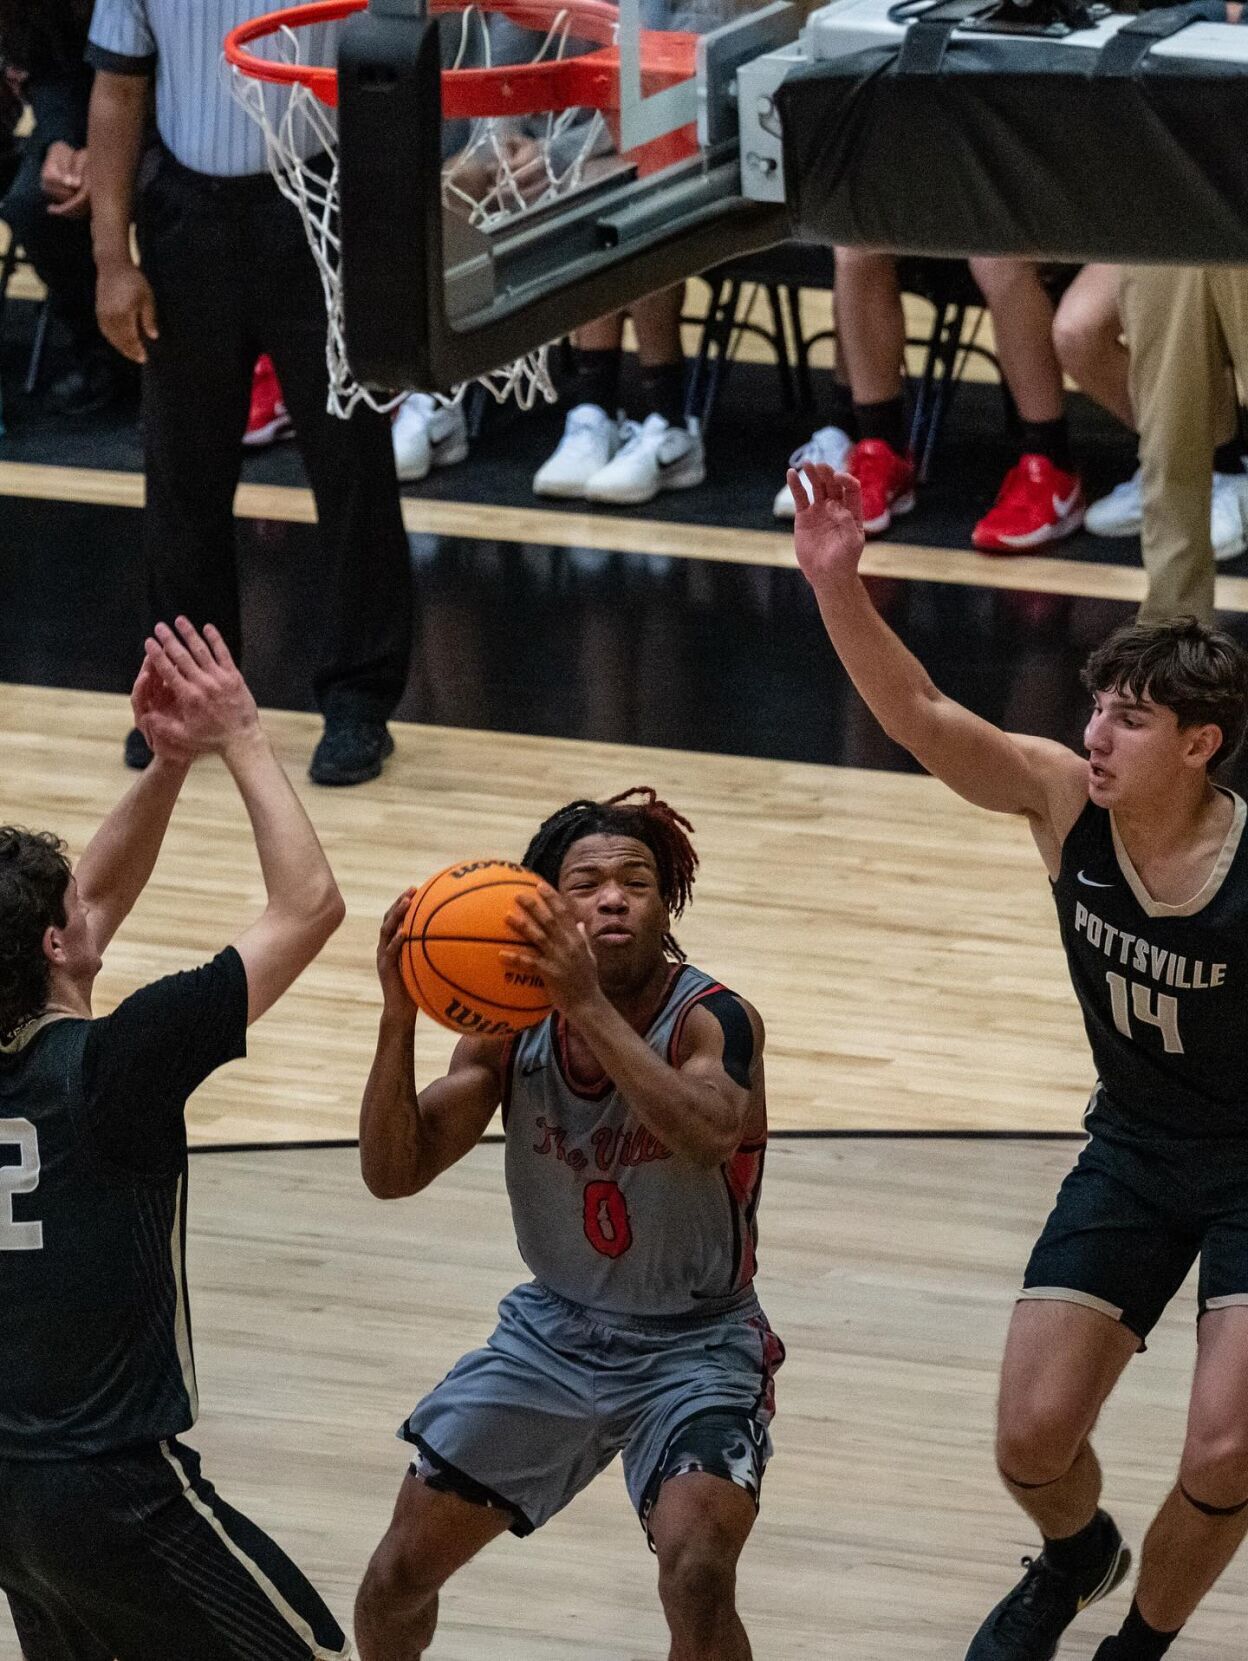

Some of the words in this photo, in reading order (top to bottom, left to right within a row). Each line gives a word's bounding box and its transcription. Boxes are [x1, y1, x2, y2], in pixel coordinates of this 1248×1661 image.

[1074, 901, 1228, 989] POTTSVILLE
[1105, 971, 1185, 1054] 14
[533, 1116, 588, 1171] The
[583, 1180, 633, 1259] 0
